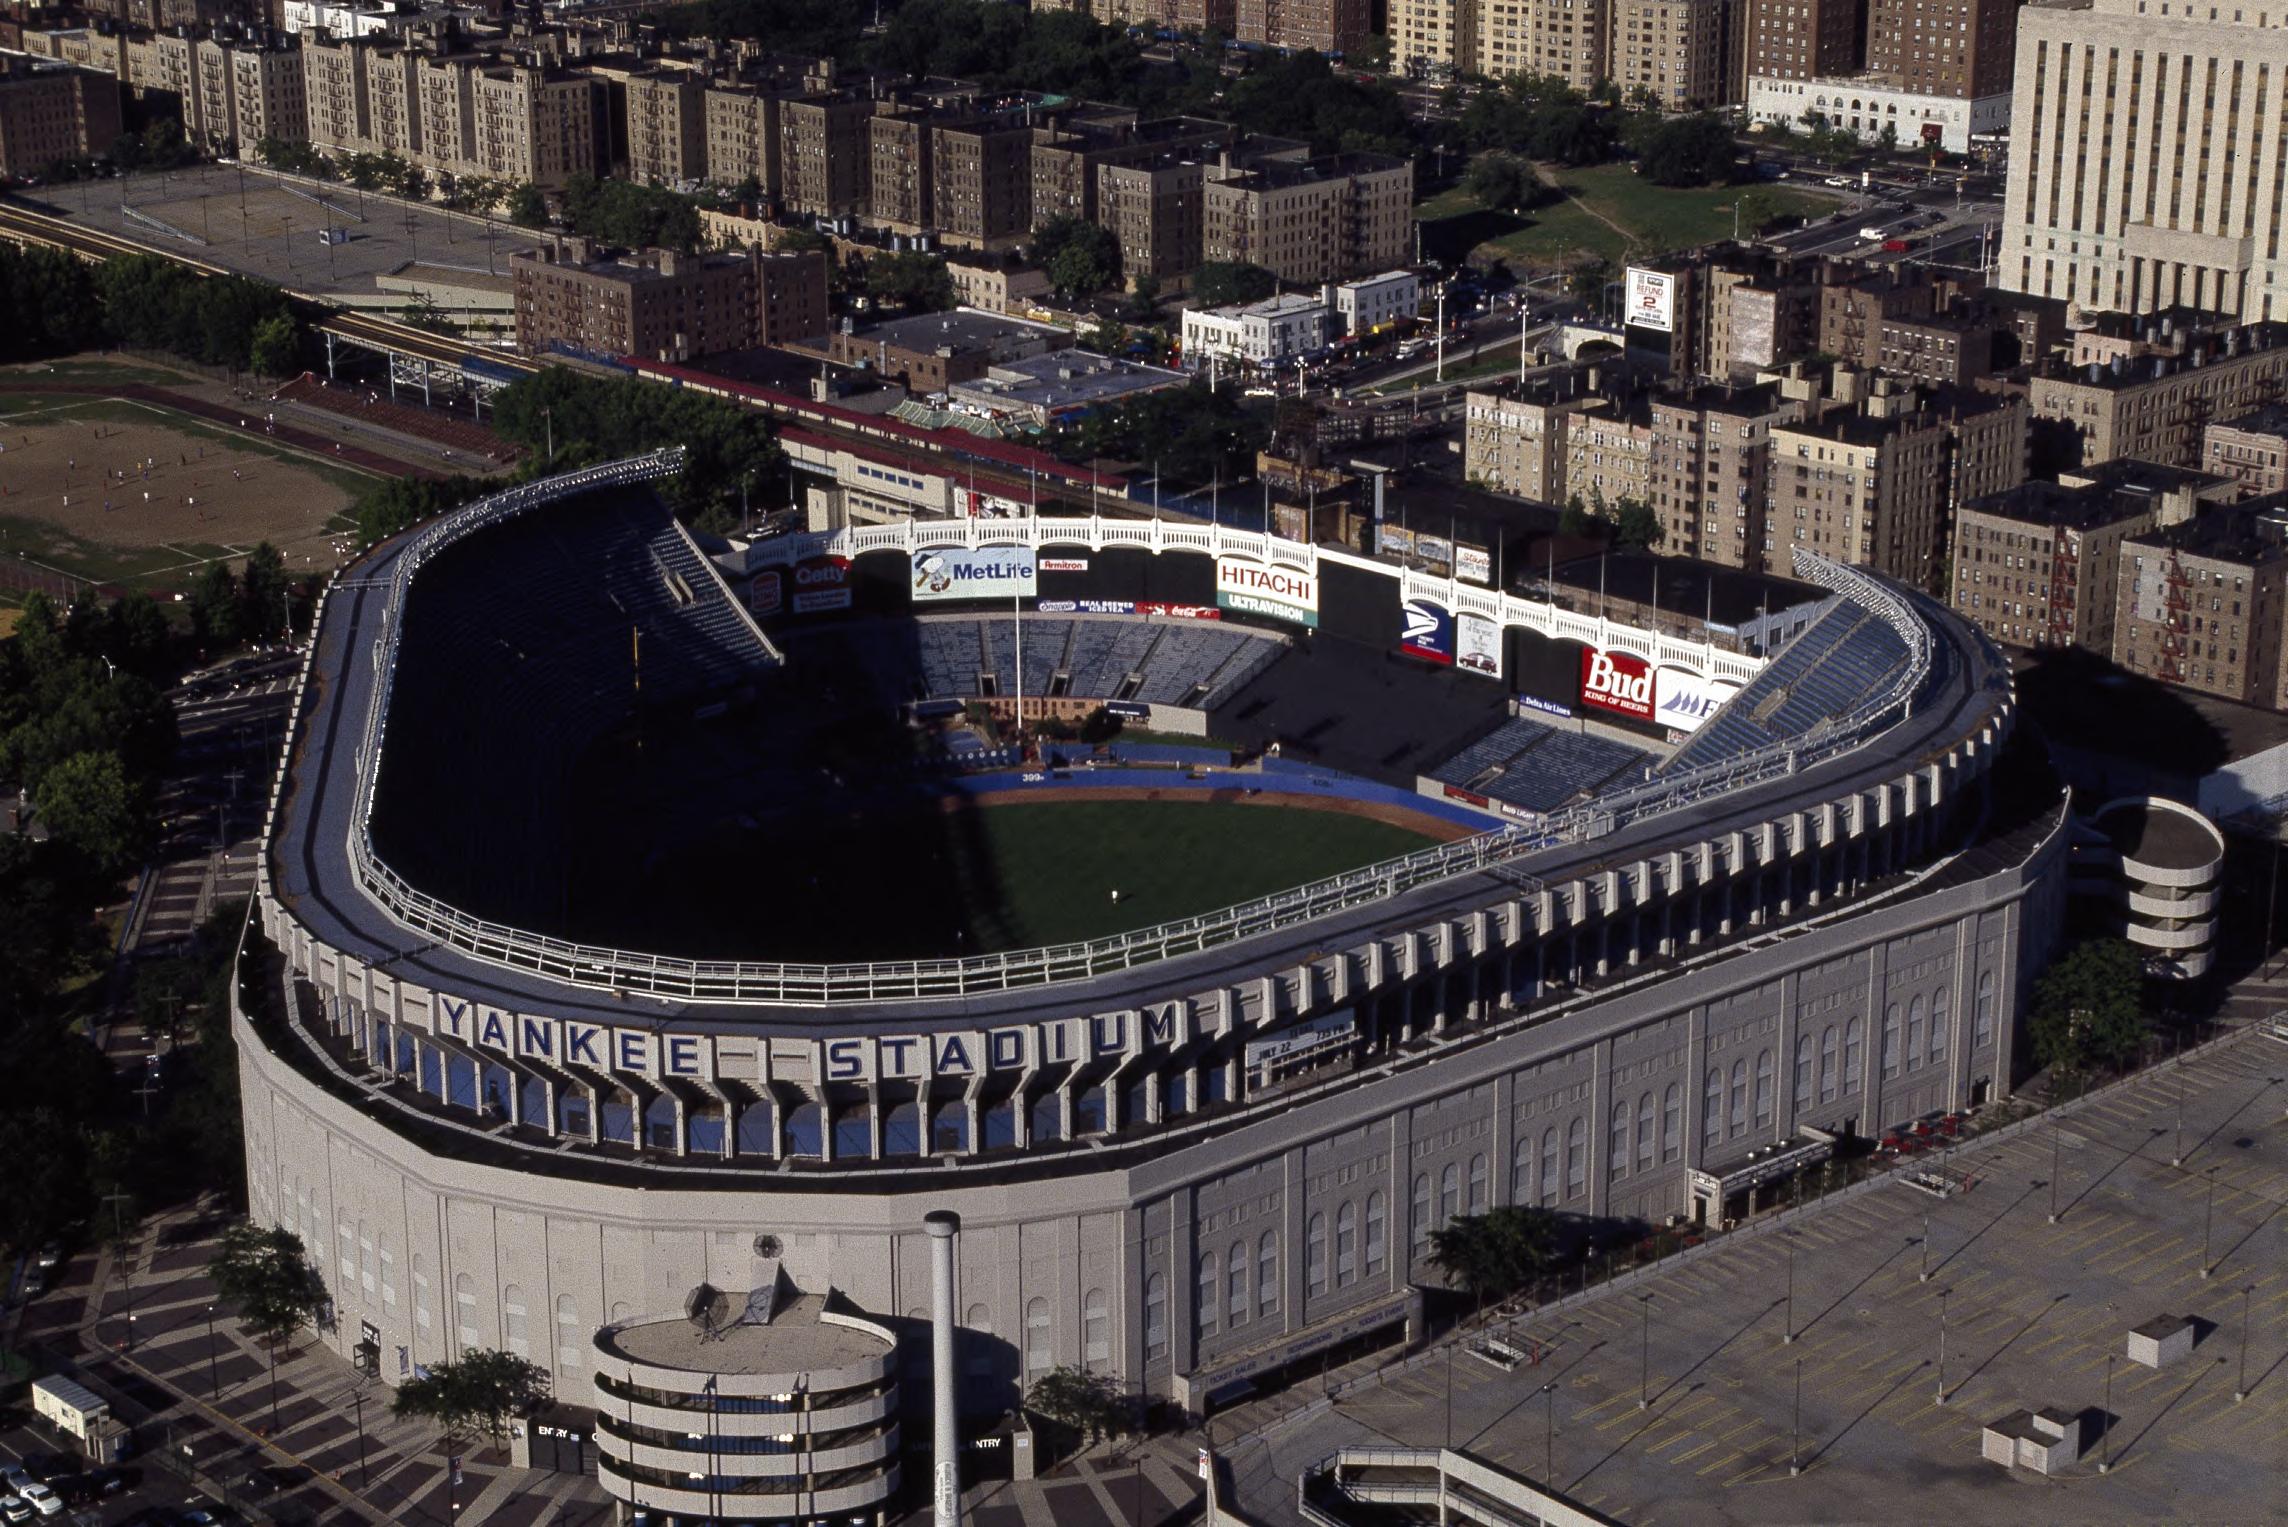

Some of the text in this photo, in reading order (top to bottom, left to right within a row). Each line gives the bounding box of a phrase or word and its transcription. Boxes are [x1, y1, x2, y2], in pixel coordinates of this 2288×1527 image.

[1643, 297, 1657, 309] 2
[953, 563, 1033, 580] MetLife
[1045, 560, 1083, 569] Armitron
[795, 566, 846, 585] Getty
[1222, 565, 1310, 600] HITACHI
[1079, 600, 1134, 609] REAL BREWED
[1088, 605, 1108, 613] ICED
[1228, 594, 1304, 622] ULTRAVISION
[1586, 654, 1656, 704] Bud
[1525, 696, 1571, 716] Delta Air Lines
[1584, 689, 1649, 714] KING OF BEERS
[1516, 808, 1535, 819] LIGHT
[442, 998, 1176, 1078] YANKEE STADIUM
[1257, 1047, 1276, 1062] JULY
[538, 1425, 568, 1438] ENTRY
